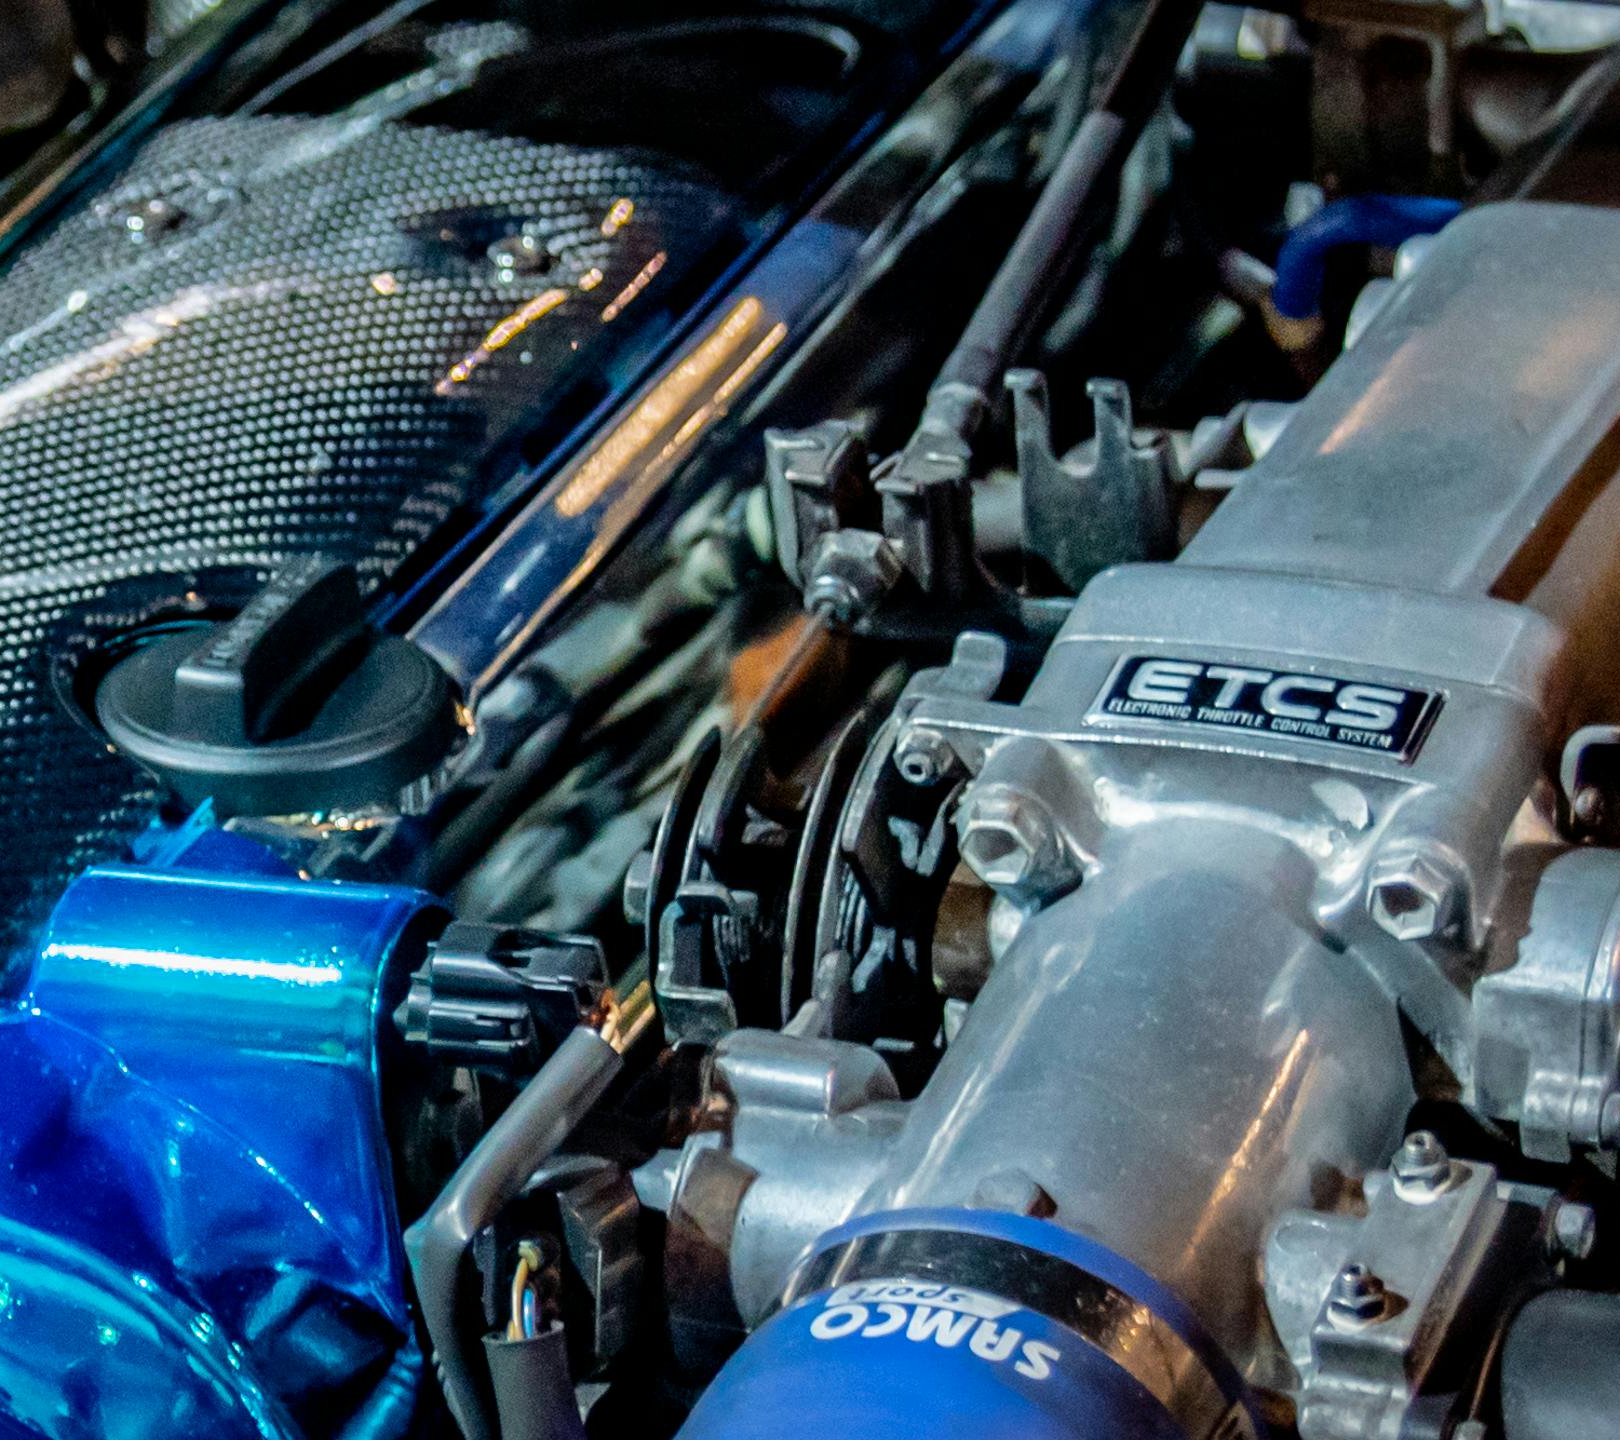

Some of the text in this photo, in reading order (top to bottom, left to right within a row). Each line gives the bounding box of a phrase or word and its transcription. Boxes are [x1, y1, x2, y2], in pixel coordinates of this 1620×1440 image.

[1107, 698, 1394, 749] ELECTRONIC THROTTLE CONTROL SYSTEM
[1126, 660, 1407, 732] ETCS
[848, 1284, 968, 1306] sport
[810, 1303, 1061, 1381] SAMCO
